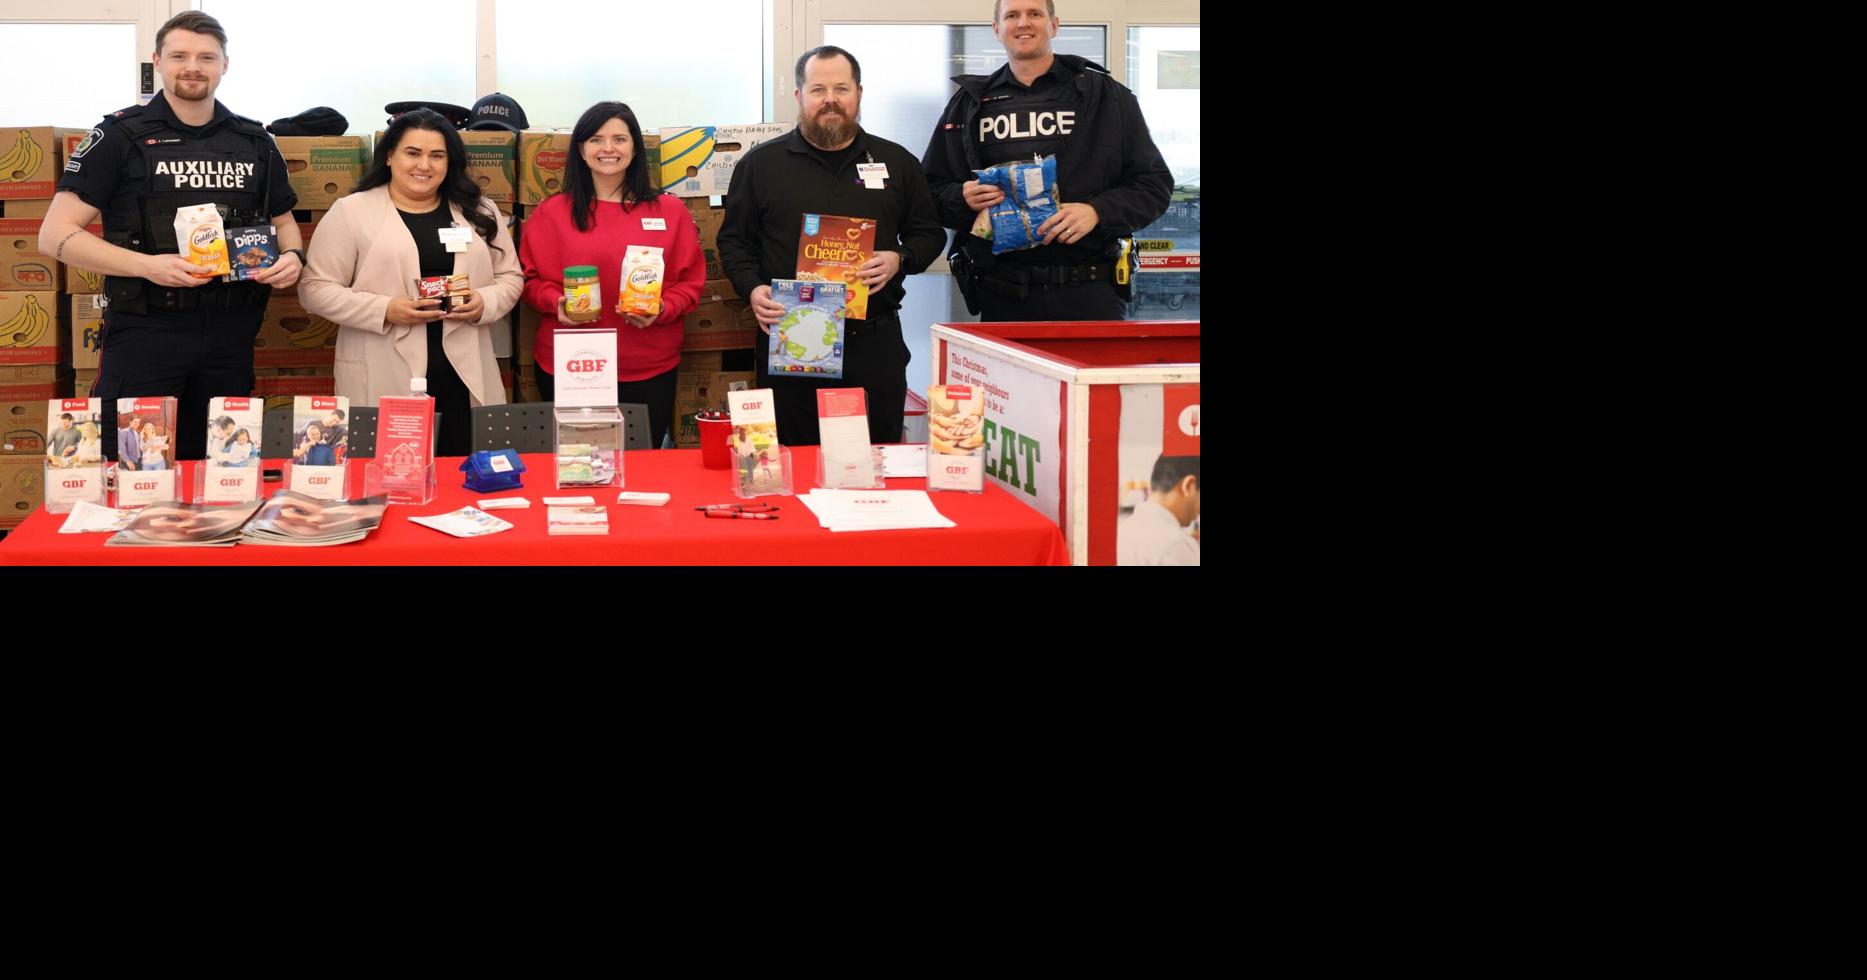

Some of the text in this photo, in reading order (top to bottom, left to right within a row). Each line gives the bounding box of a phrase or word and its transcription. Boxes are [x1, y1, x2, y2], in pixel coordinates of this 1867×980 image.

[477, 105, 510, 118] POLICE
[979, 111, 1076, 143] POLICE
[312, 156, 352, 164] Premium
[471, 152, 504, 160] remium
[155, 161, 255, 176] AUXILIARY
[312, 164, 352, 172] BANANA
[471, 160, 503, 168] ANANA
[175, 174, 245, 188] POLICE
[194, 229, 219, 246] Goldfish
[234, 232, 268, 248] Dipps
[821, 239, 860, 250] Honey Nut
[1150, 241, 1169, 250] CLEAR
[804, 244, 865, 262] Cheerios
[1138, 257, 1168, 265] ERGENCY
[632, 272, 657, 283] Goldfish
[421, 278, 446, 289] Snack
[427, 284, 447, 294] pack
[951, 353, 961, 366] This
[566, 359, 608, 373] GBF
[951, 369, 963, 382] some
[964, 373, 970, 383] of
[982, 381, 1009, 400] neighbours
[742, 402, 764, 411] GBF
[946, 466, 969, 474] GBF
[62, 479, 87, 489] GBF
[220, 478, 245, 487] GBF
[308, 476, 332, 485] GBF
[134, 482, 159, 491] GBF
